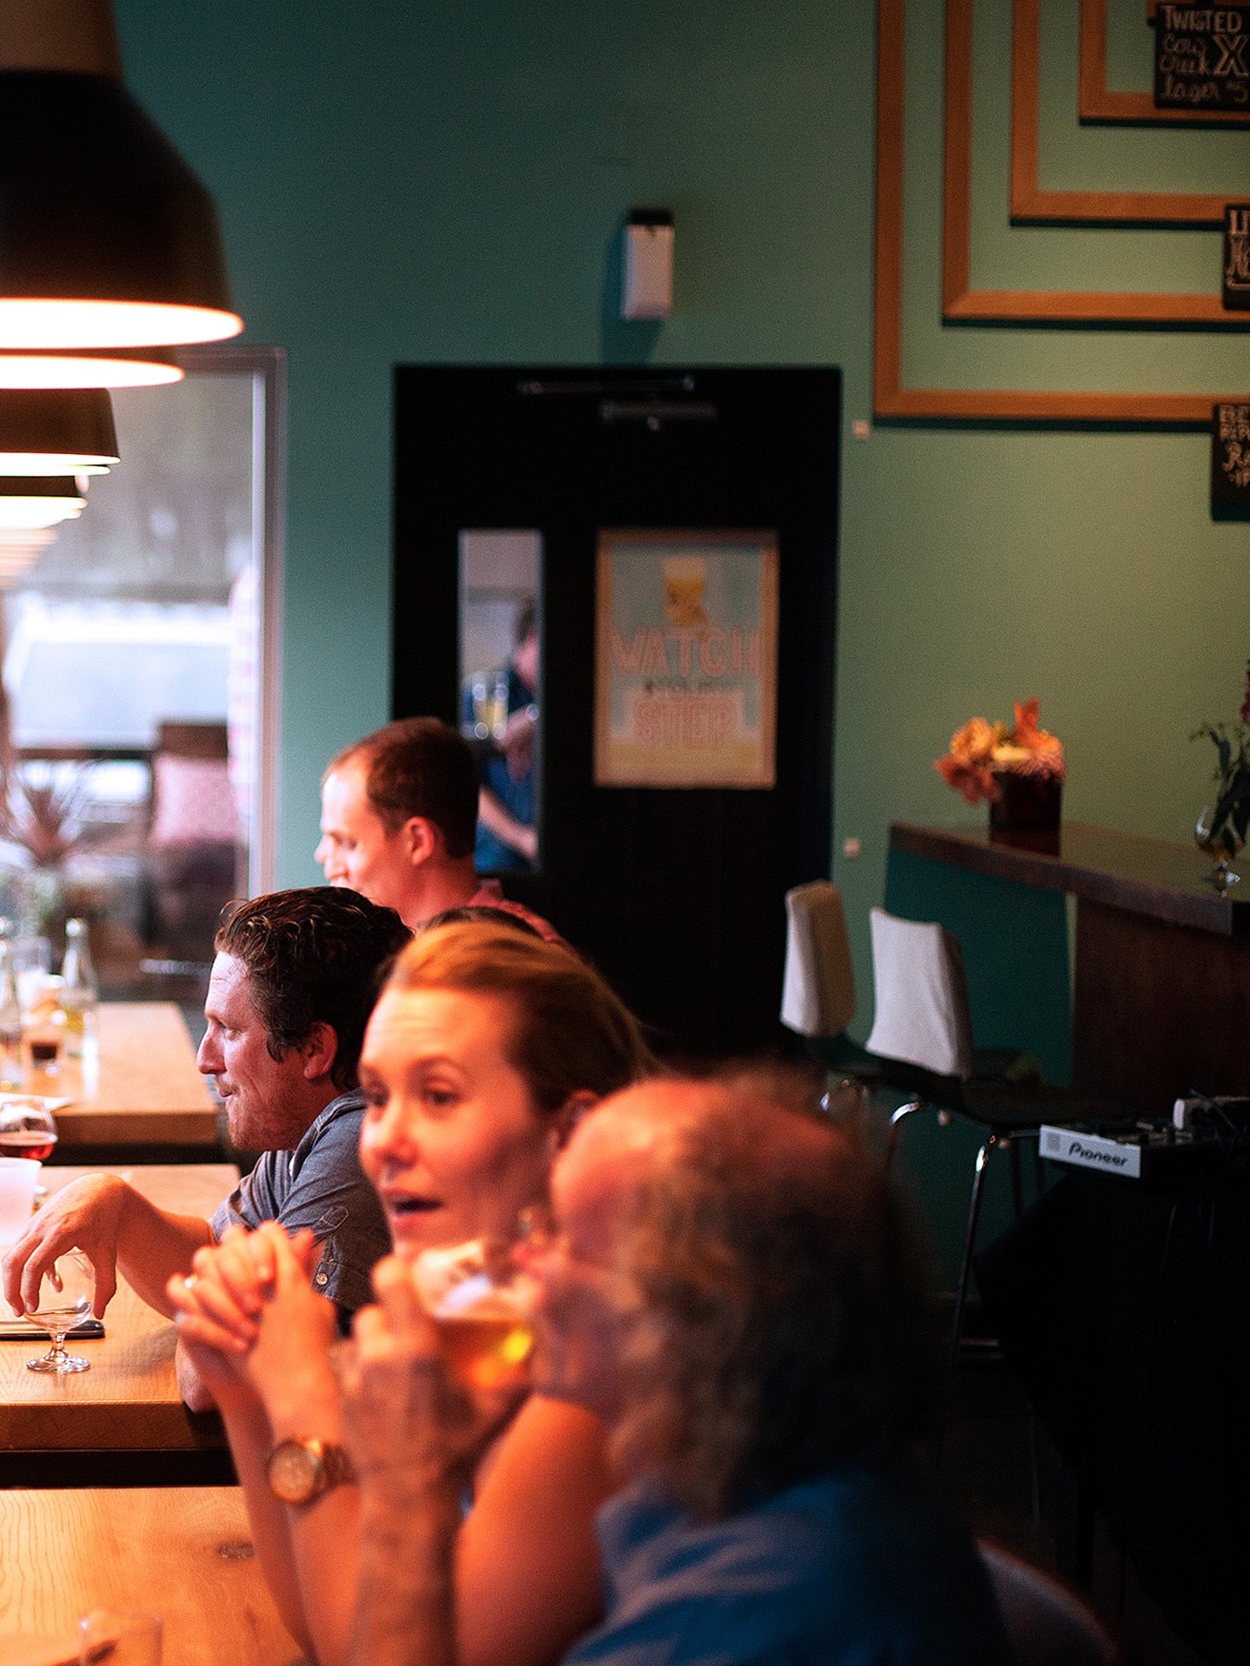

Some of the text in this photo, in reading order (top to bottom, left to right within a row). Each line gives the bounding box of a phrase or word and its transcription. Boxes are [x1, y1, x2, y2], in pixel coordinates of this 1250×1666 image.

[1160, 5, 1242, 33] TWISTED
[1212, 33, 1249, 78] X
[609, 626, 761, 677] WATCH
[634, 699, 736, 749] STEP
[1068, 1141, 1128, 1167] Pioneer
